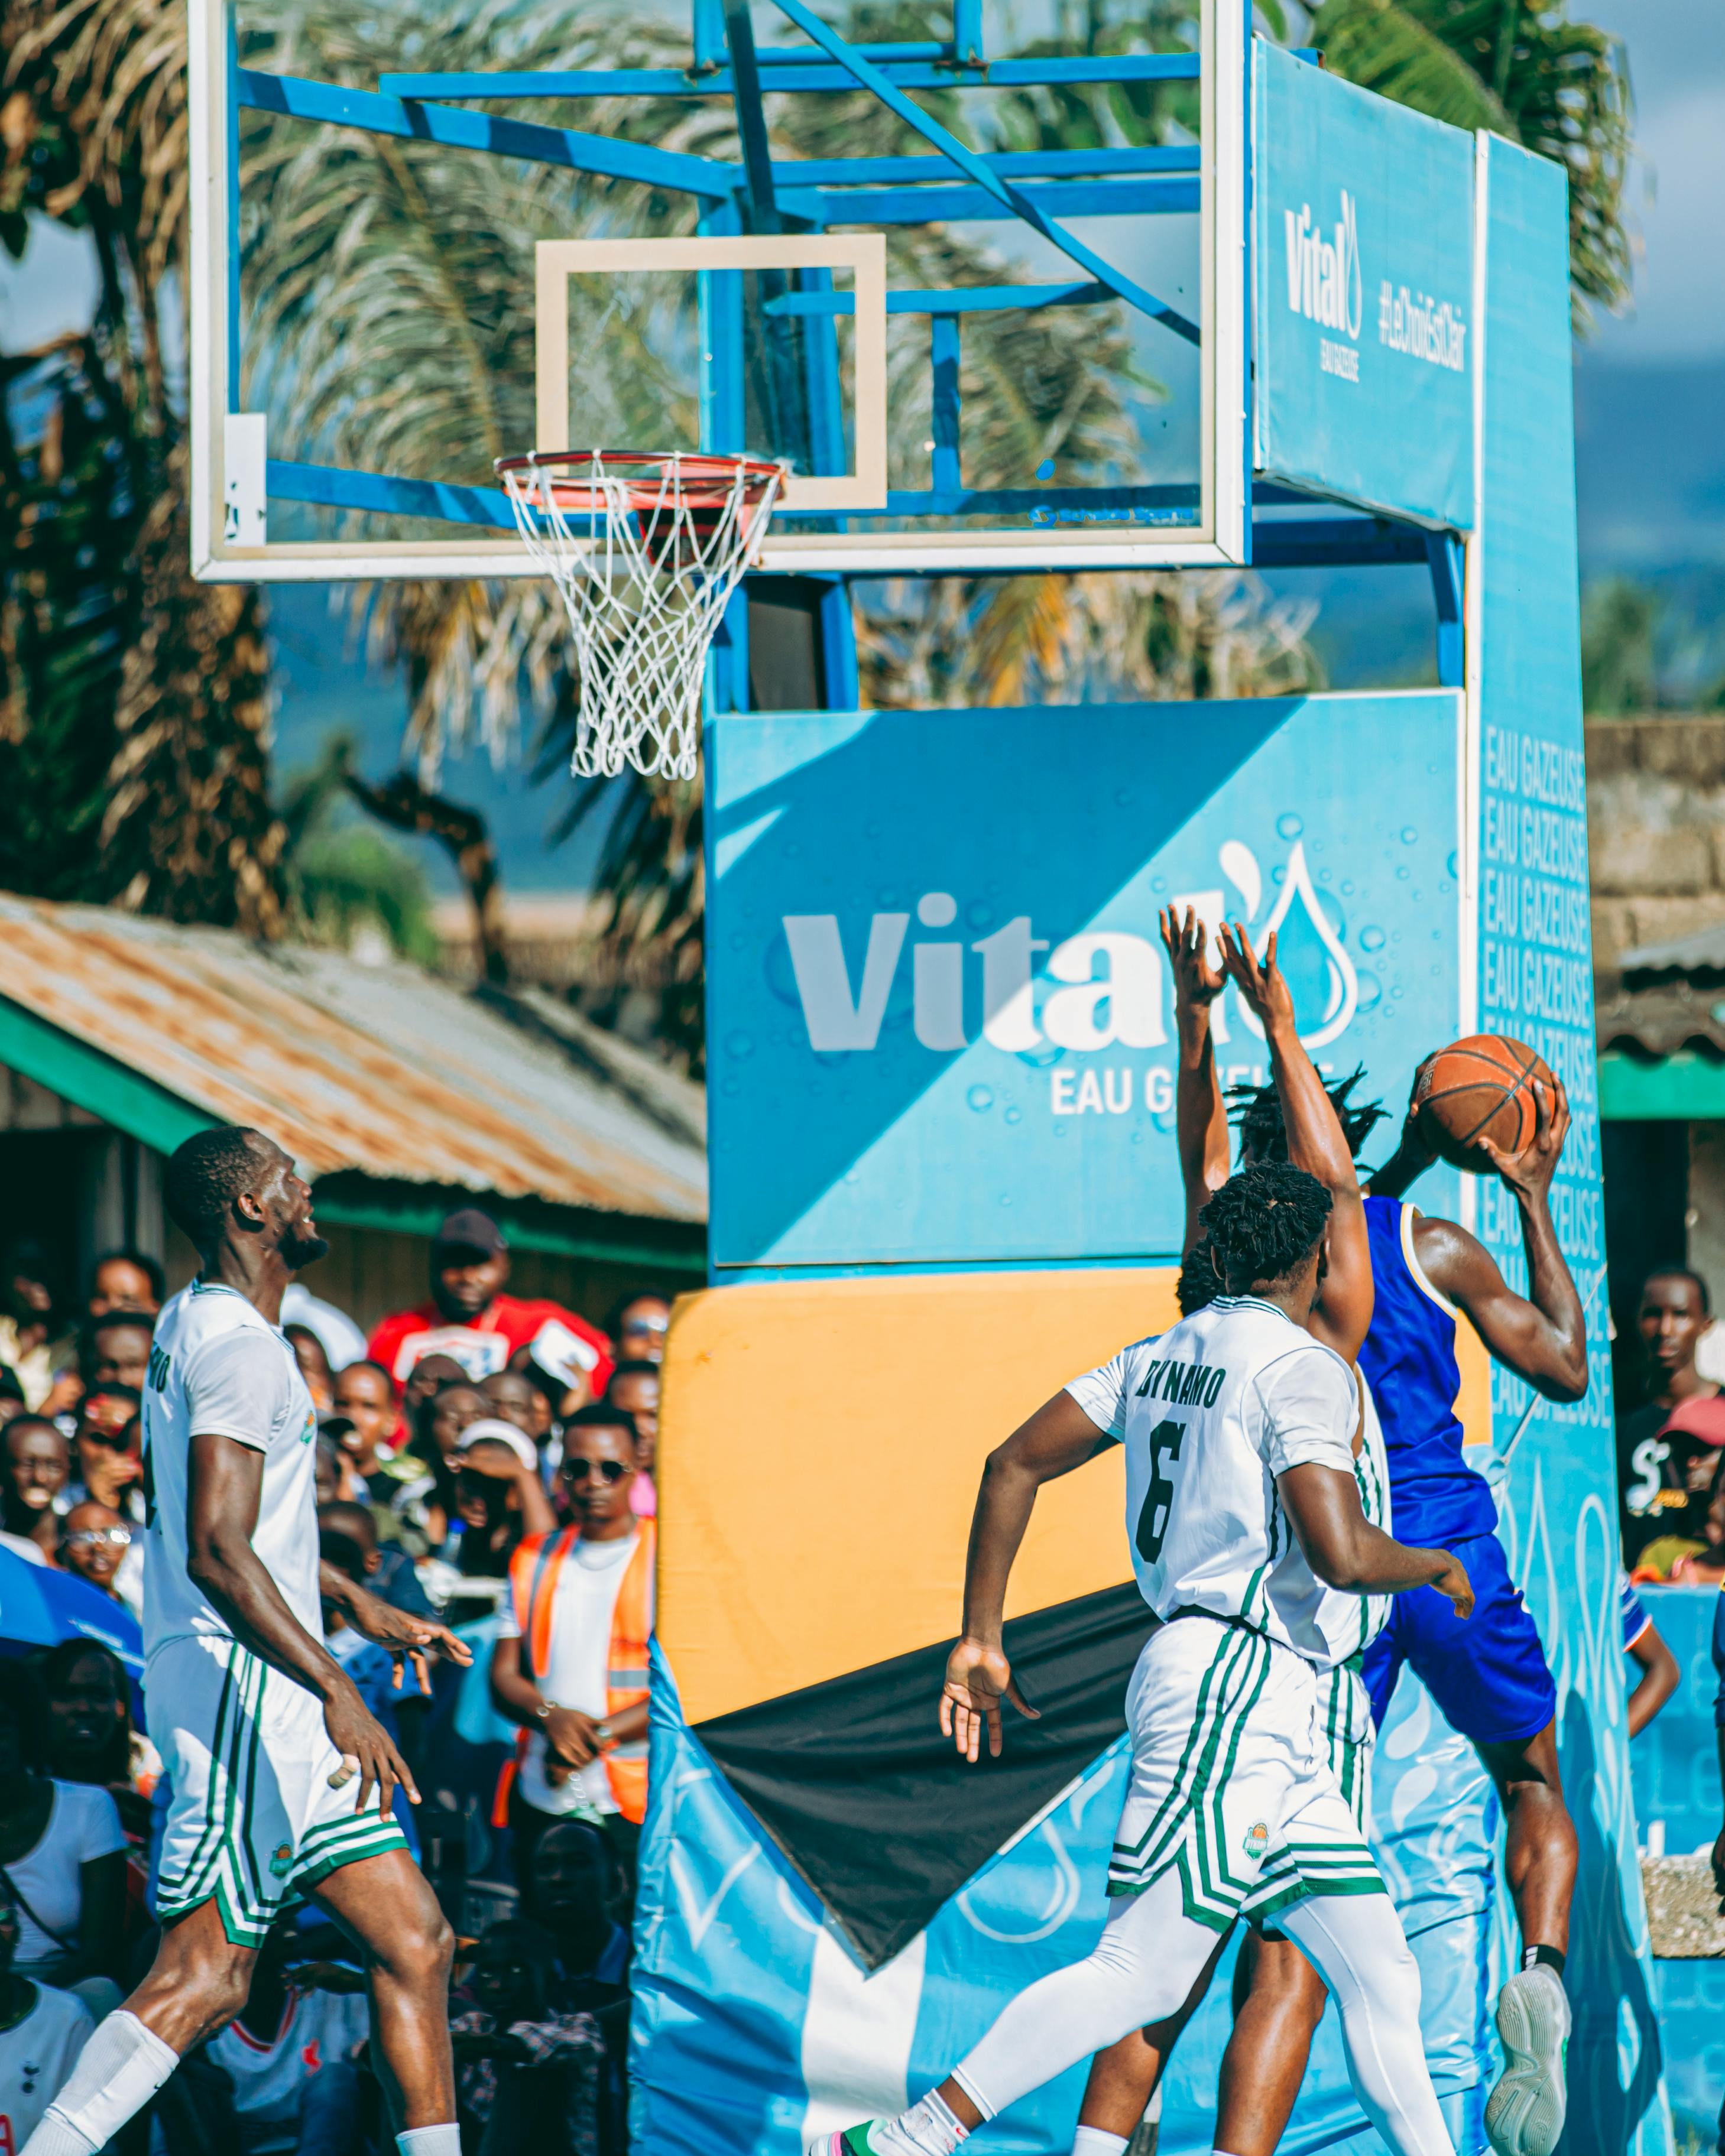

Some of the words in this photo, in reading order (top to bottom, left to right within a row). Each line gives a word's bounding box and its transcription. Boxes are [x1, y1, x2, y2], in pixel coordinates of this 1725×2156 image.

[1285, 202, 1346, 332] Vital
[1486, 725, 1518, 794] EAU
[1521, 733, 1584, 813] GAZEUSE
[1485, 795, 1518, 865] EAU
[1521, 804, 1586, 885] GAZEUSE
[1484, 868, 1518, 939] EAU
[1522, 876, 1587, 956] GAZEUSE
[1484, 941, 1519, 1012] EAU
[1522, 947, 1590, 1030] GAZEUSE
[1050, 1068, 1133, 1115] EAU
[1135, 1360, 1227, 1409] DYNAMO
[1135, 1420, 1186, 1565] 6
